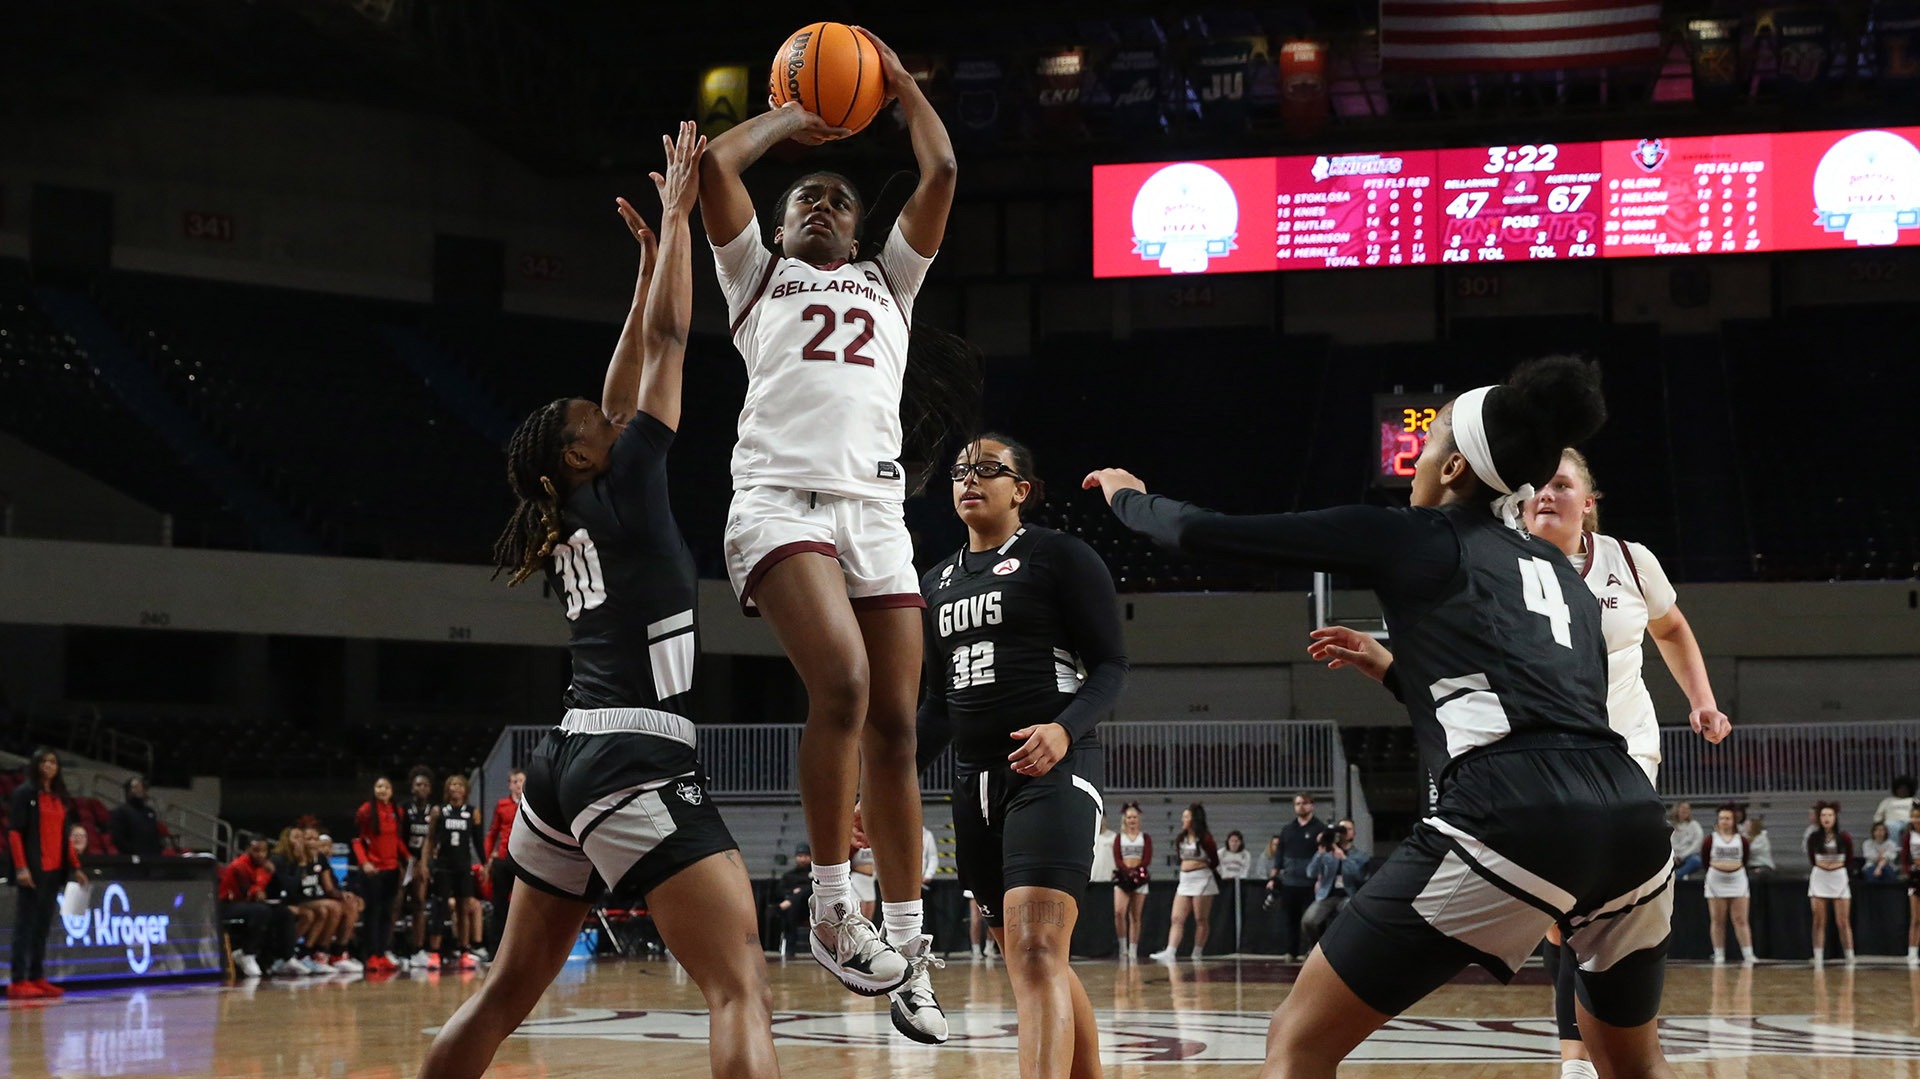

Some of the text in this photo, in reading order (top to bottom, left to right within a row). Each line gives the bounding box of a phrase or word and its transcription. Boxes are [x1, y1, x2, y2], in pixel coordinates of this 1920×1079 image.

[1202, 72, 1243, 101] JU
[1483, 144, 1558, 174] 3:22
[1694, 161, 1764, 175] PTS FLS REB
[1363, 176, 1430, 189] PTS FLS REB
[1514, 181, 1526, 193] 4
[1367, 189, 1377, 200] 0
[1389, 189, 1399, 200] 0
[1412, 188, 1422, 199] 0
[1548, 185, 1592, 213] 67
[1389, 202, 1399, 213] 0
[1412, 201, 1423, 212] 0
[1445, 192, 1490, 219] 47
[1610, 207, 1619, 217] 4
[189, 214, 231, 239] 341
[1293, 219, 1336, 231] BUTLER
[1366, 217, 1380, 227] 14
[1390, 216, 1399, 227] 4
[1502, 215, 1540, 229] POSS
[1293, 233, 1351, 244] HARRISON
[1367, 230, 1377, 241] 0
[1485, 234, 1496, 246] 2
[1722, 230, 1733, 241] 4
[1747, 229, 1757, 240] 4
[1390, 244, 1399, 254] 4
[1442, 247, 1505, 262] FLS TOL
[1529, 244, 1596, 259] TOL FLS
[1654, 242, 1691, 254] TOTAL
[1325, 256, 1360, 267] TOTAL
[1458, 276, 1499, 297] 301
[802, 304, 875, 367] 22
[1403, 407, 1437, 433] 3:2
[550, 527, 608, 621] 30
[1517, 555, 1573, 650] 4
[938, 591, 1003, 638] GOVS
[952, 640, 996, 690] 32
[93, 883, 170, 975] Kroger
